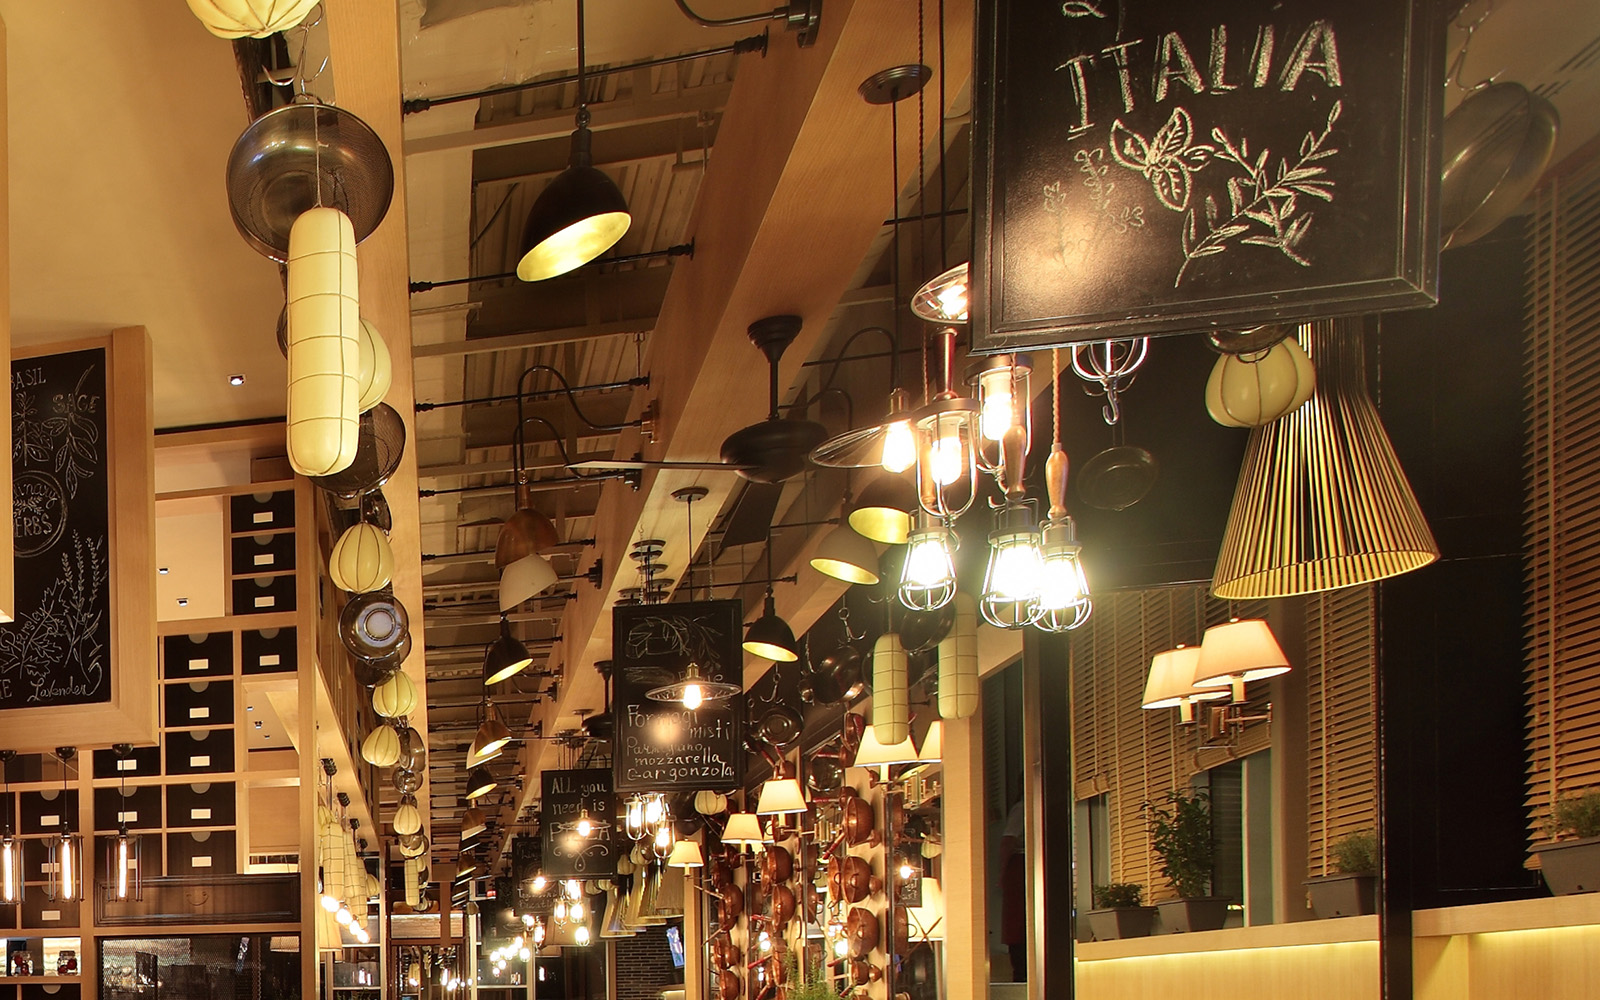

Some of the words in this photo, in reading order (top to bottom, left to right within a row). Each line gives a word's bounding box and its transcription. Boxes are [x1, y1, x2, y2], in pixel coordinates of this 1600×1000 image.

[1055, 19, 1341, 140] ITALIA
[14, 512, 53, 538] ERBS
[26, 671, 99, 703] Lavender
[689, 718, 731, 741] misti
[634, 746, 722, 767] mozzarella
[581, 782, 608, 798] you
[593, 799, 606, 812] is
